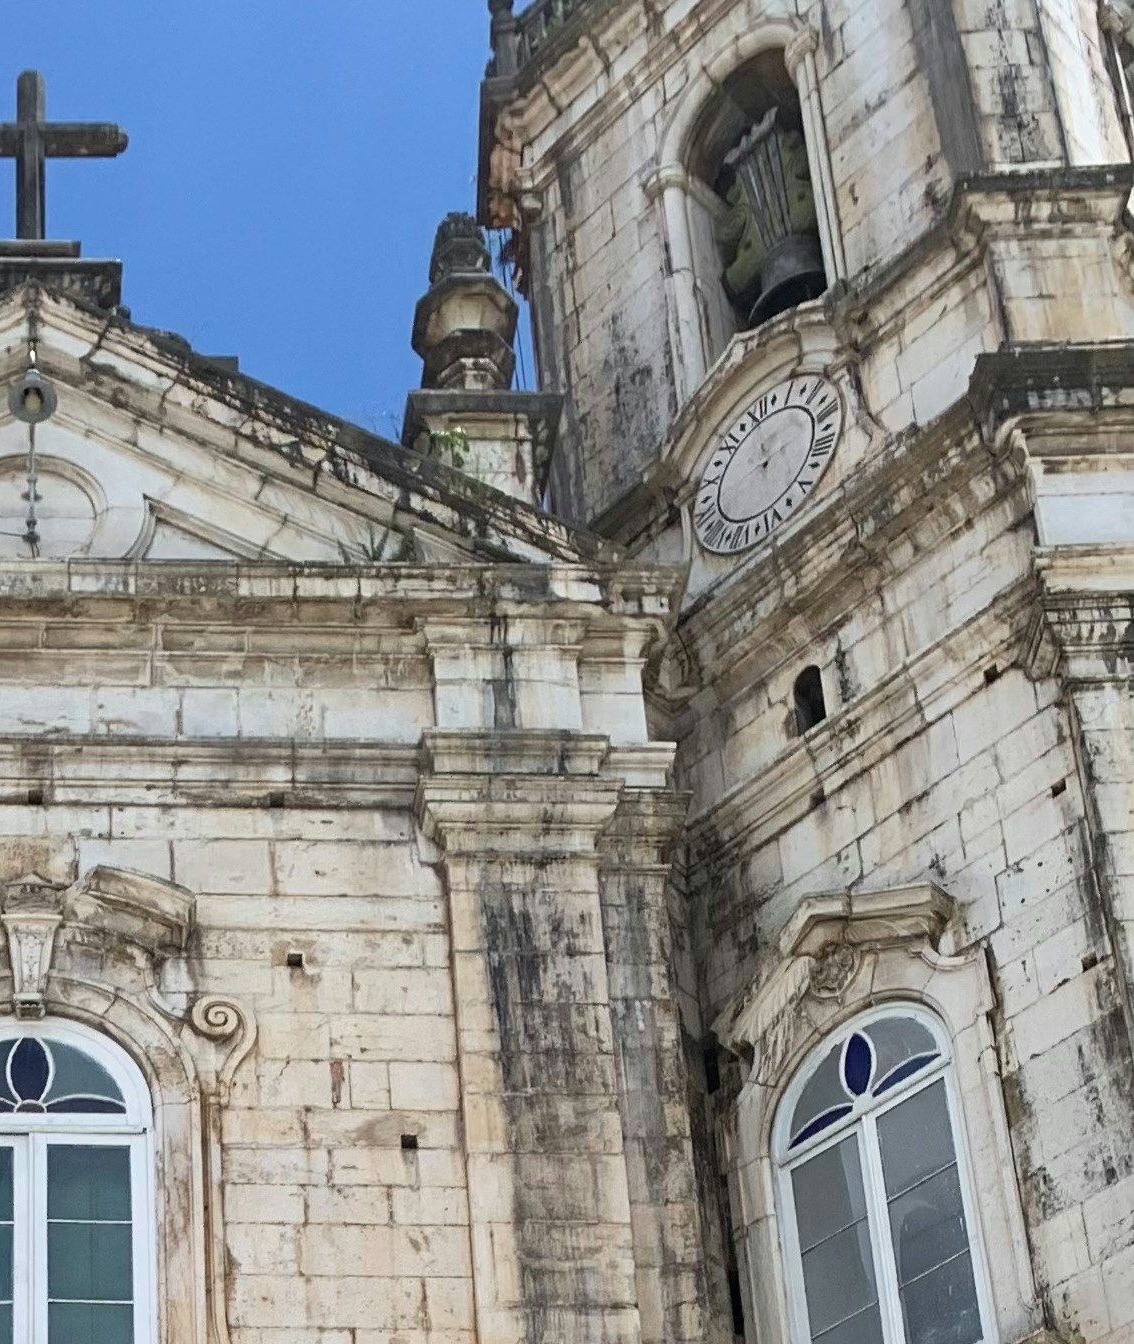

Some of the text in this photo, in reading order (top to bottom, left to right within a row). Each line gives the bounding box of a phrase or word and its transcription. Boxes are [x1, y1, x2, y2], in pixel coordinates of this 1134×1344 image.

[805, 380, 825, 405] II
[747, 395, 767, 427] XII
[816, 398, 839, 423] III
[718, 433, 740, 455] XI
[811, 432, 835, 457] IIII
[700, 475, 720, 490] X
[797, 481, 814, 494] V
[764, 508, 783, 532] VI
